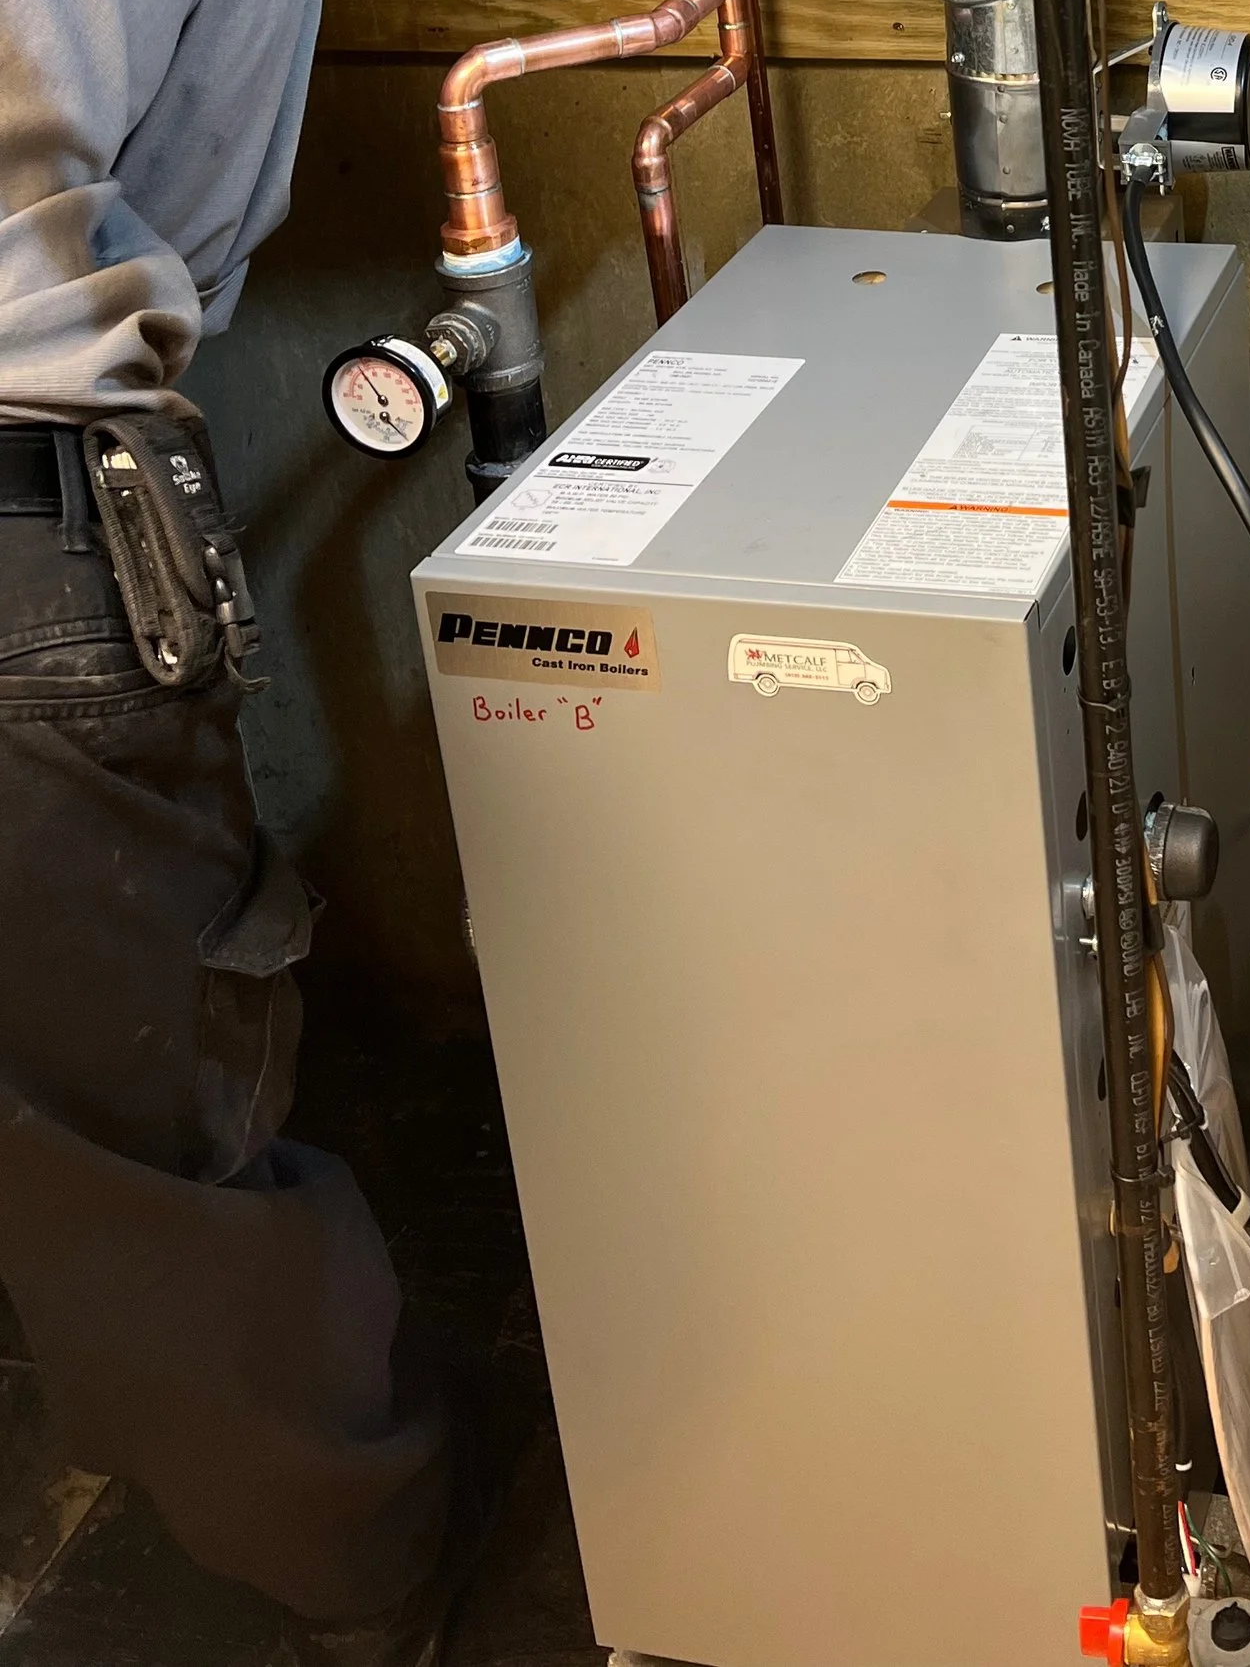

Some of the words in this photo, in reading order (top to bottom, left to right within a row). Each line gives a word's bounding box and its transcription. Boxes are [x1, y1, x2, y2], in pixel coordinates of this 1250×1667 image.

[1073, 260, 1097, 302] Made
[1078, 339, 1103, 399] Canada
[437, 612, 613, 655] PENNCO
[532, 657, 563, 670] Cast
[568, 660, 595, 672] Iron
[600, 663, 649, 676] Boilers
[764, 652, 827, 666] METCALF
[472, 696, 547, 721] Boiler
[557, 697, 602, 730] "B"
